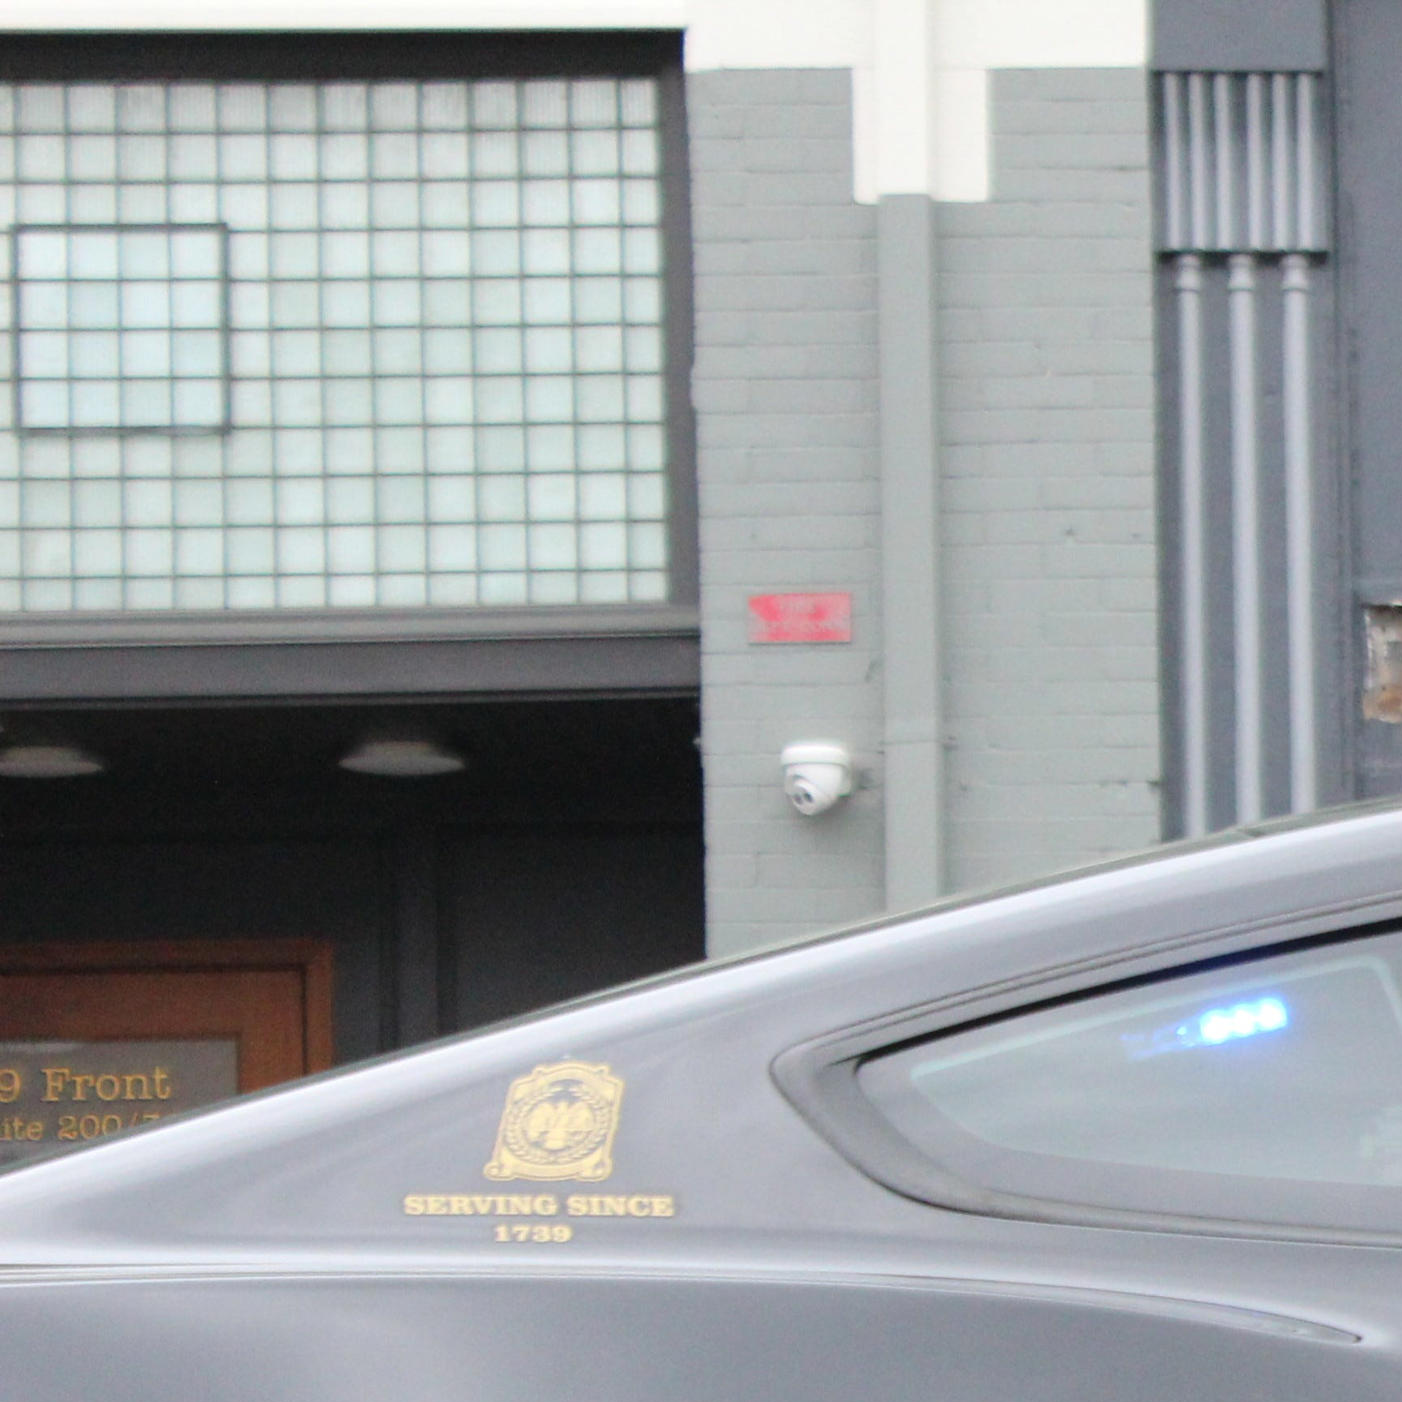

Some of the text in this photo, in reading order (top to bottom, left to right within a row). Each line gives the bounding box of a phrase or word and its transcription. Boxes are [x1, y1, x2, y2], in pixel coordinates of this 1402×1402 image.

[41, 1065, 172, 1102] Front
[403, 1194, 675, 1217] SERVING SINCE
[495, 1224, 573, 1243] 1739
